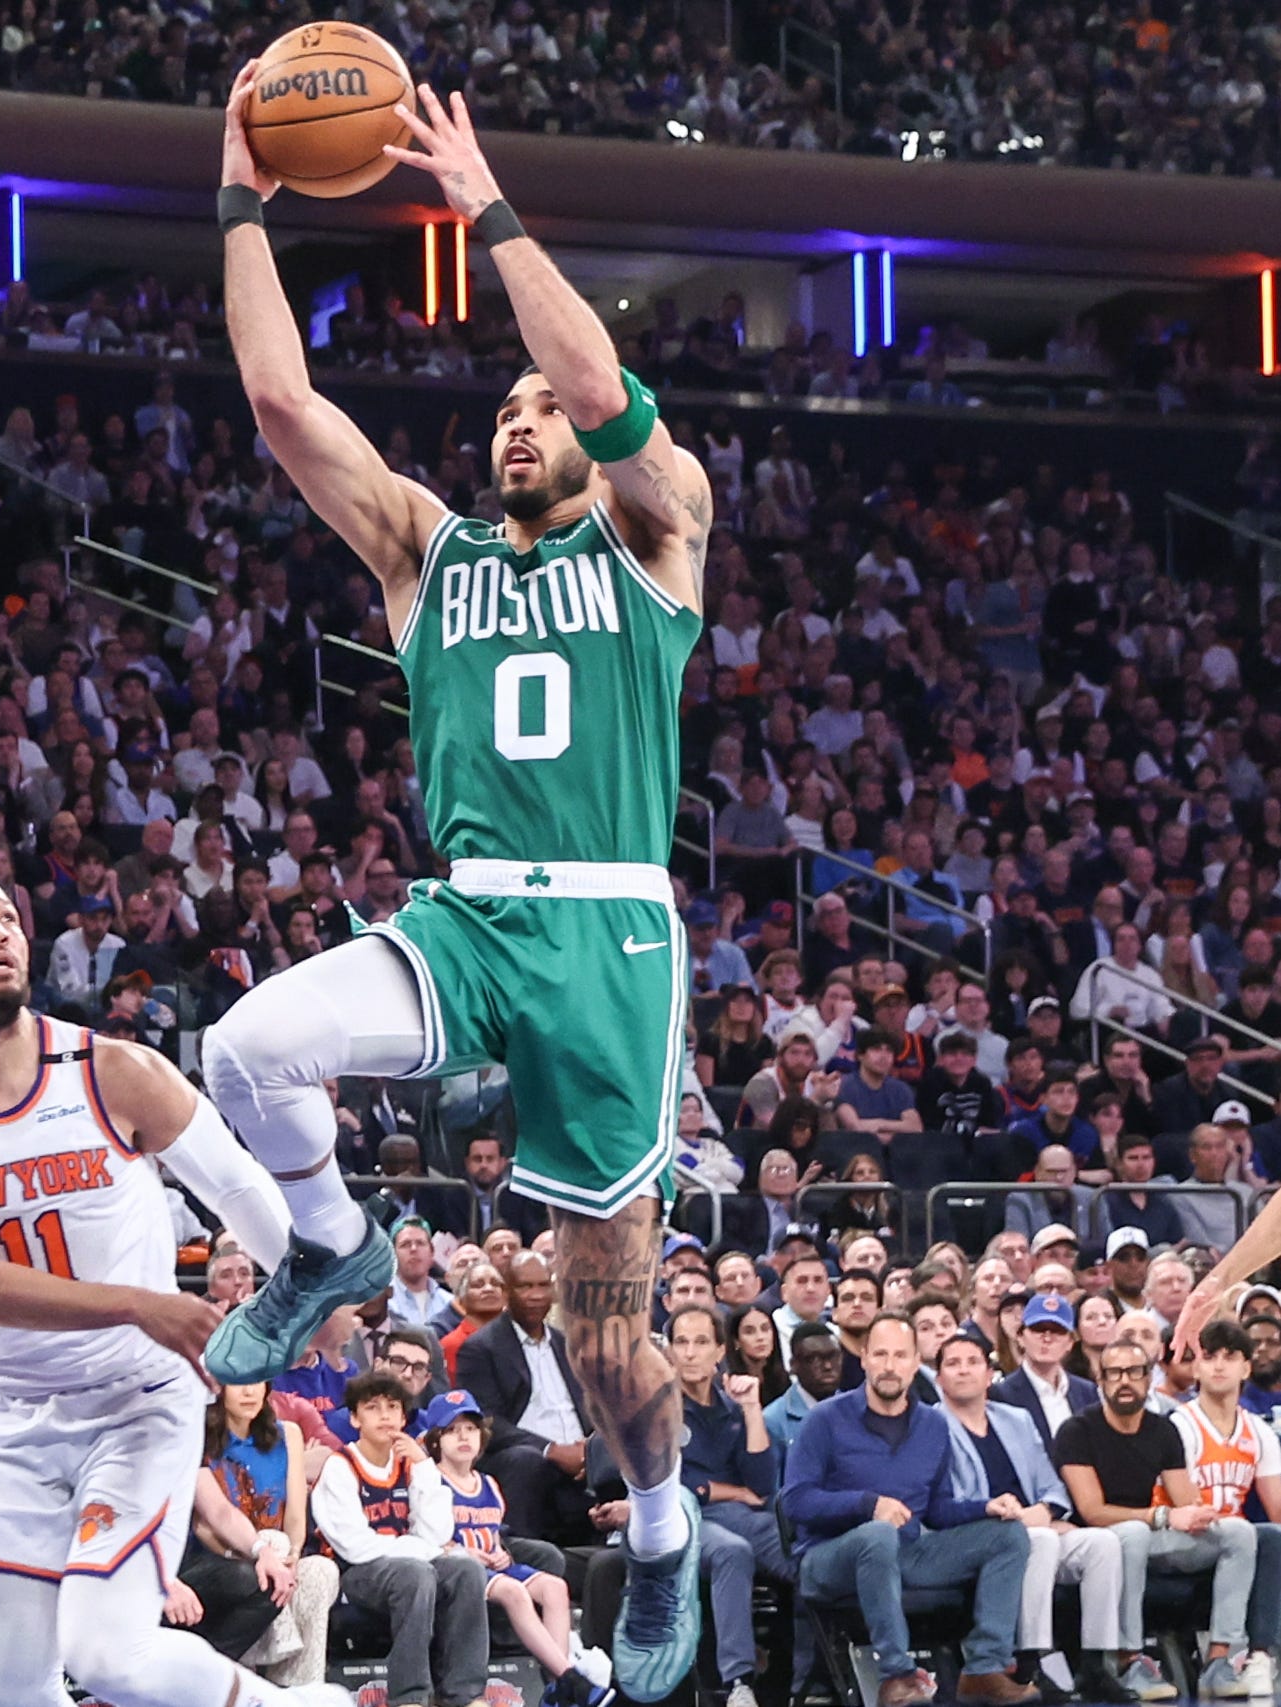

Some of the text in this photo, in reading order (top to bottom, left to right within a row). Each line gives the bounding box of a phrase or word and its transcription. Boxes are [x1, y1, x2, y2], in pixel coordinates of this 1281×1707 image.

[260, 67, 369, 103] Wilson
[442, 553, 621, 650] BOSTON
[494, 652, 570, 760] 0
[9, 1147, 114, 1202] YORK
